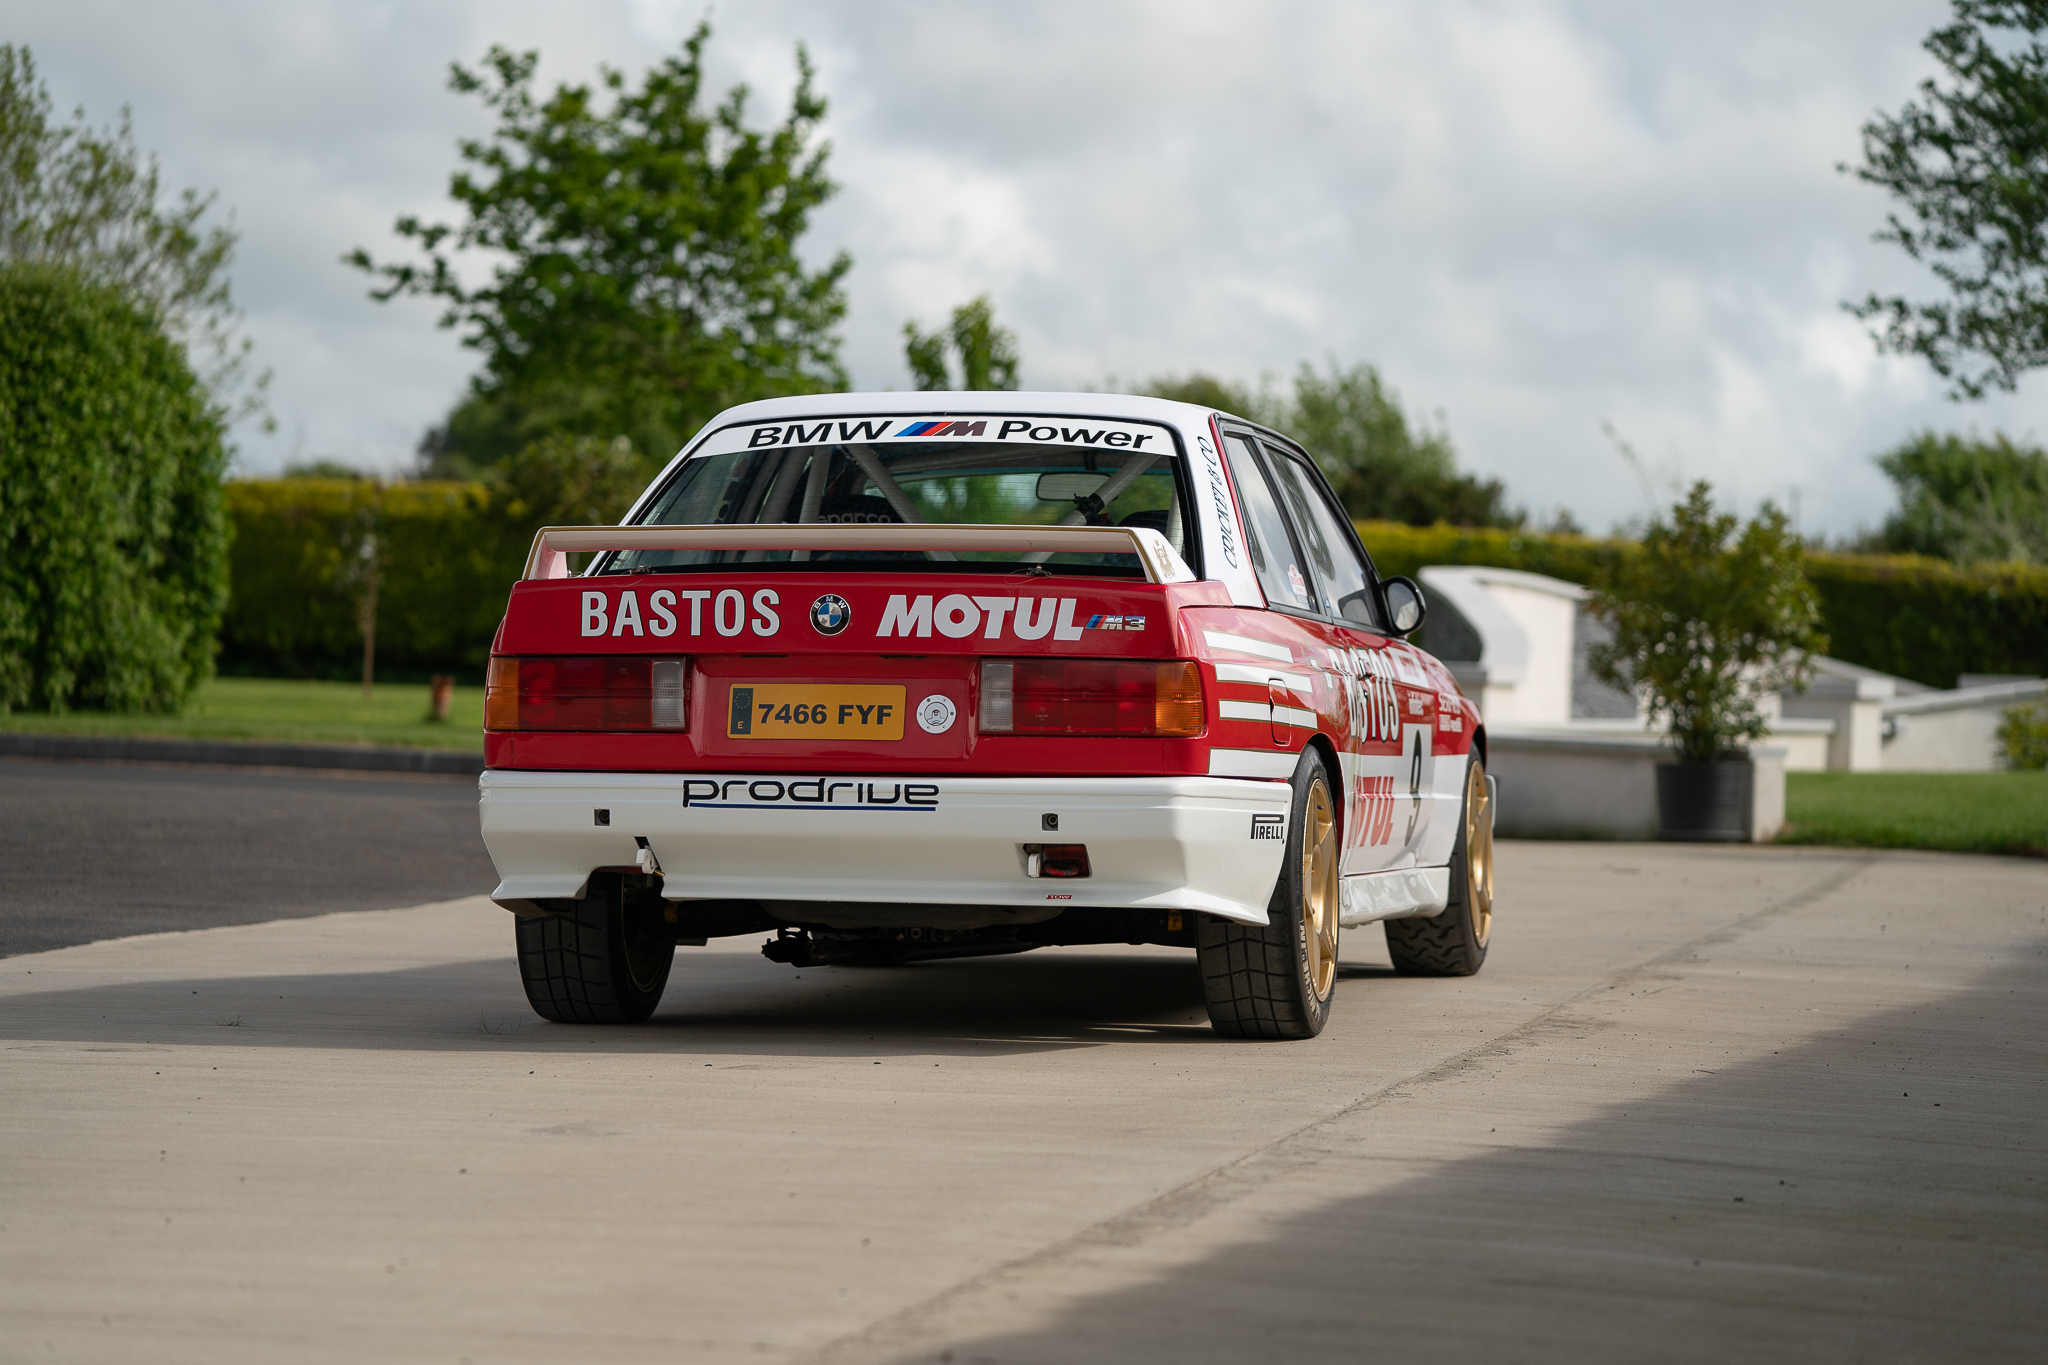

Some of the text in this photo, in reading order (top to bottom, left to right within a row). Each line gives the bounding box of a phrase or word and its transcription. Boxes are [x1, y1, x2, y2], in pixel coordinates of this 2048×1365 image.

[748, 421, 894, 448] BMW
[997, 420, 1153, 449] Power
[1197, 436, 1216, 466] CO
[1211, 481, 1237, 569] CRICKET
[581, 589, 781, 637] BASTOS
[876, 594, 1085, 641] MOTUL
[737, 721, 744, 729] E
[758, 704, 893, 725] 7466 FYF
[683, 778, 939, 808] prodrive
[1405, 730, 1421, 847] 9
[1251, 814, 1284, 839] PIRELLI
